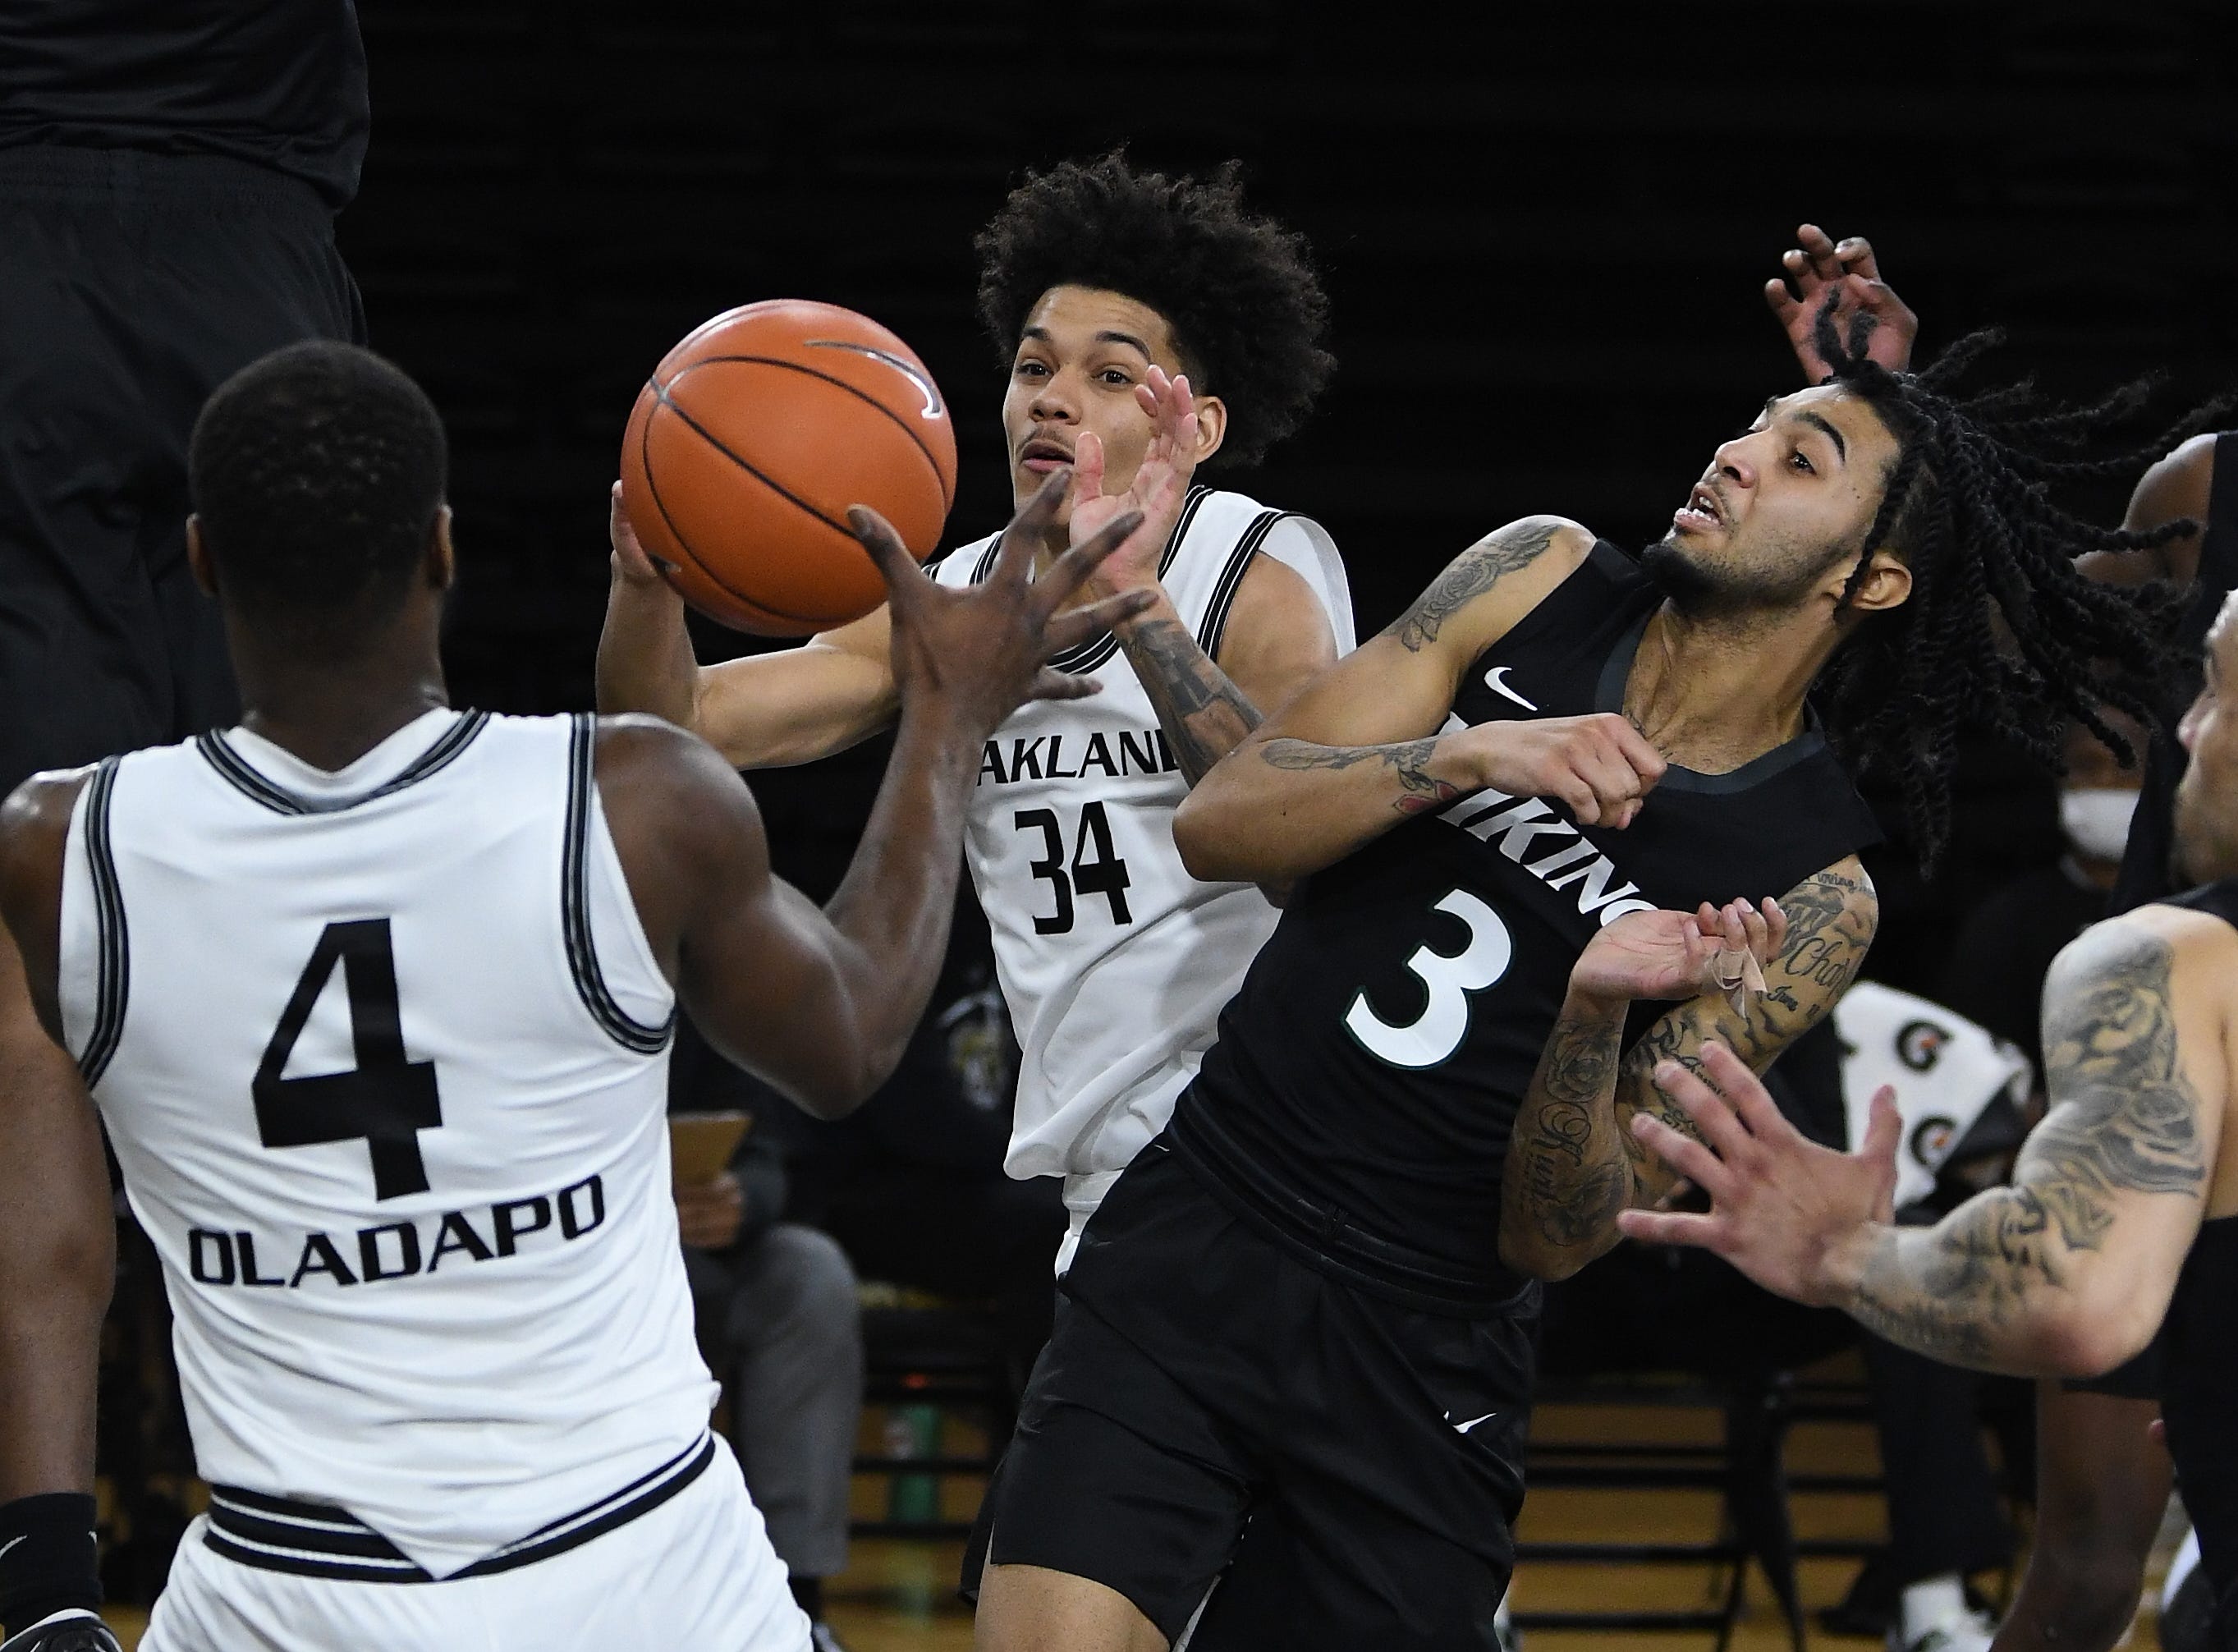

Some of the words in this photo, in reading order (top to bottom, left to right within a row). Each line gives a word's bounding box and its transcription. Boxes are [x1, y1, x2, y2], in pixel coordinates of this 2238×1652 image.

[1014, 801, 1132, 934] 34
[1436, 711, 1658, 927] IKIN
[251, 917, 443, 1202] 4
[1344, 887, 1513, 1068] 3
[187, 1174, 607, 1288] OLADAPO
